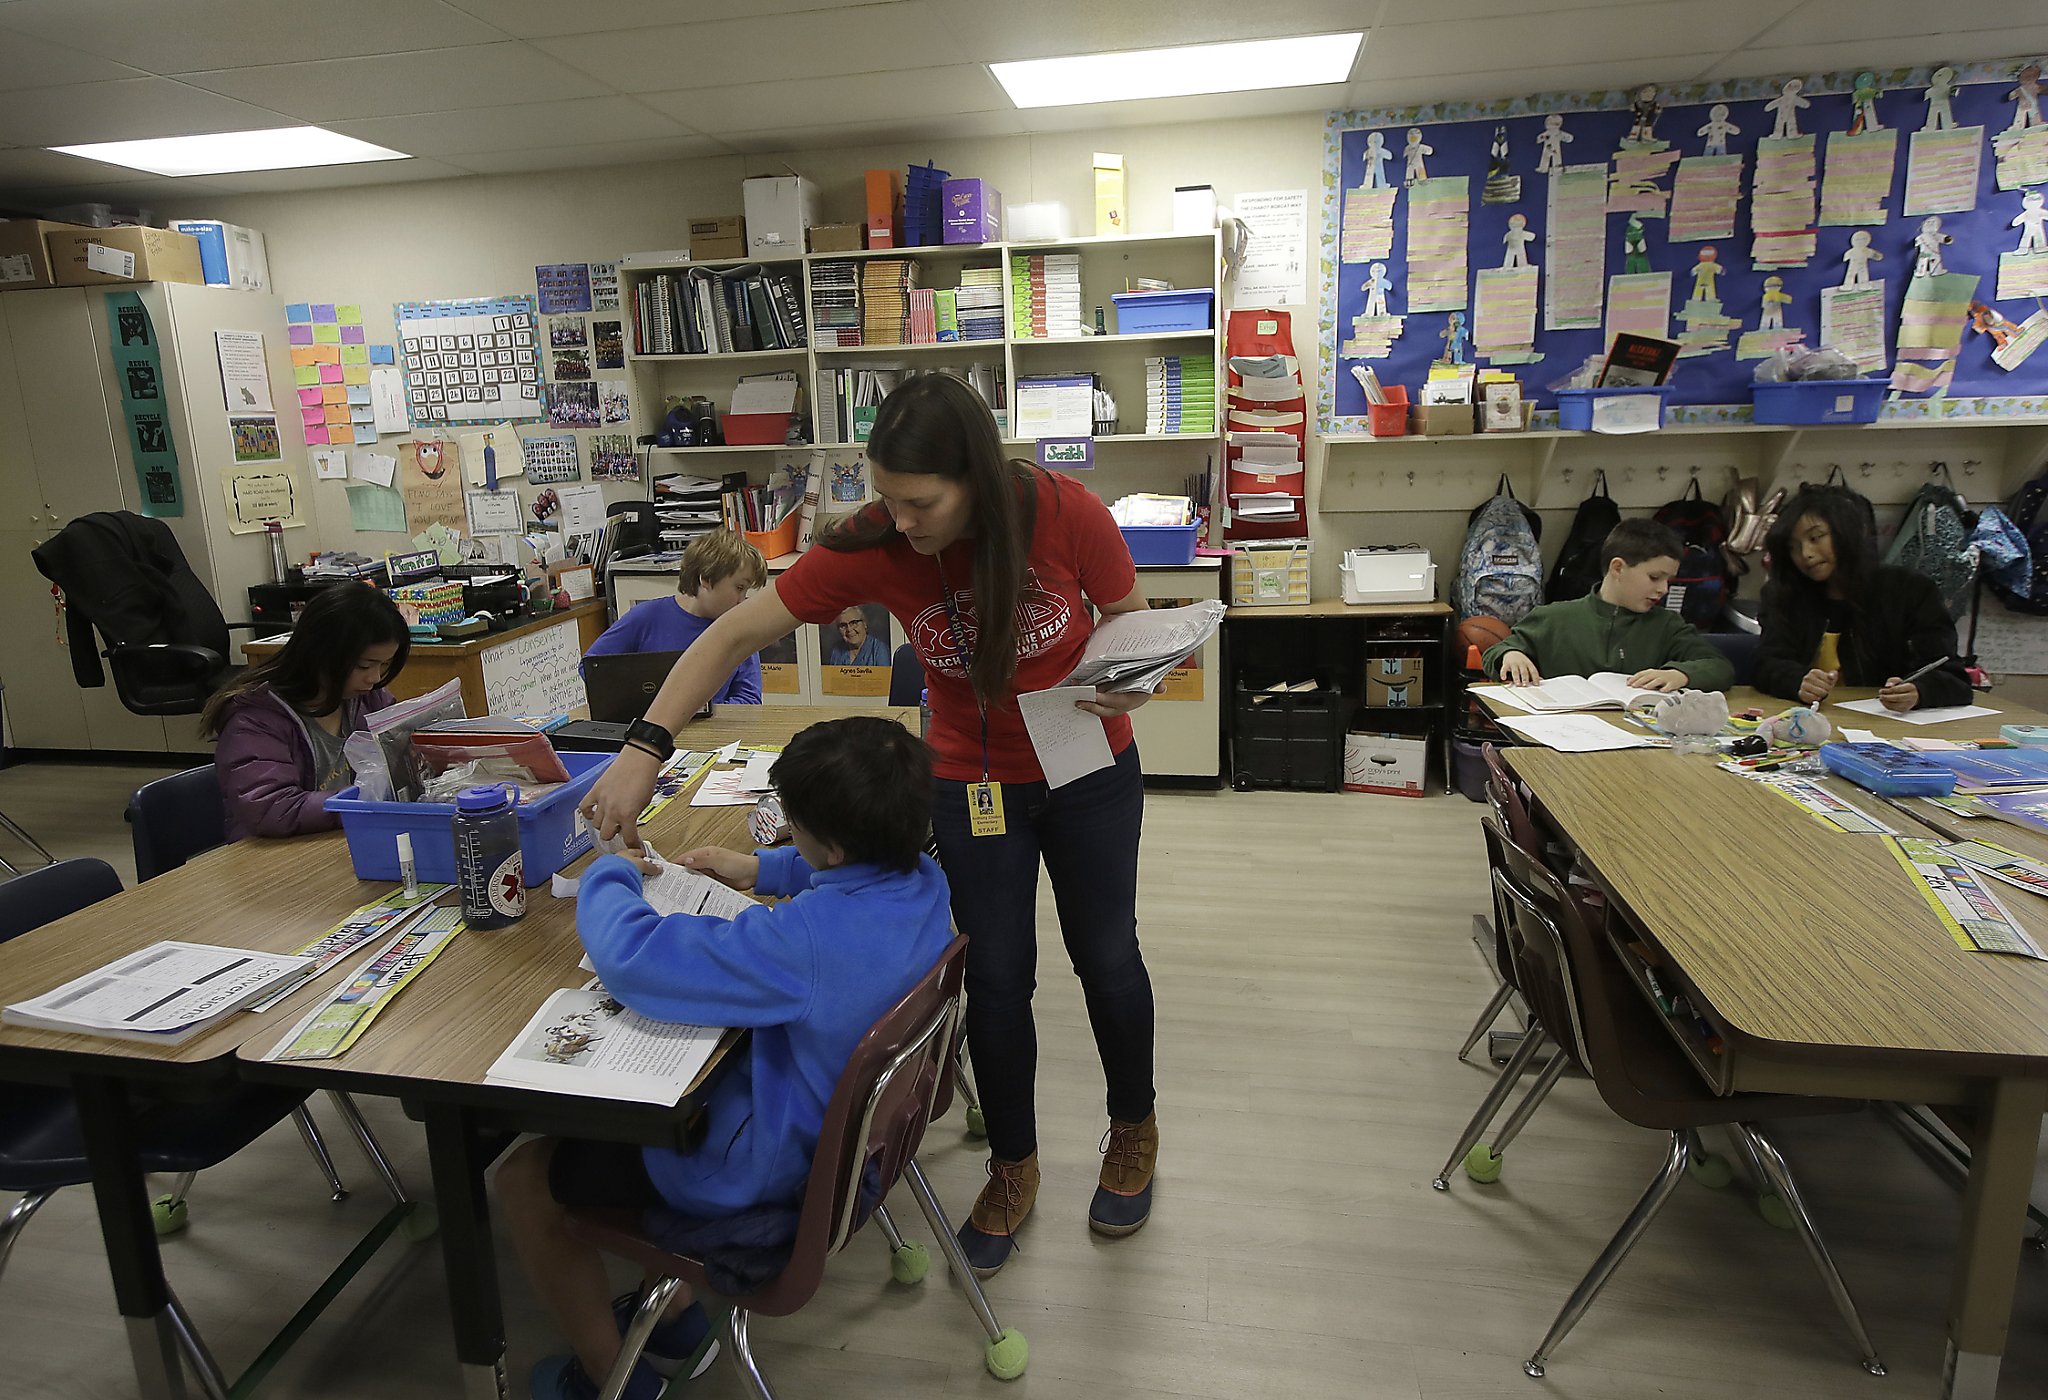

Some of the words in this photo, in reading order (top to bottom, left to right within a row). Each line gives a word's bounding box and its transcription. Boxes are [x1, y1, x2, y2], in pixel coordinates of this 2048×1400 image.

[500, 319, 506, 329] 1
[516, 316, 524, 326] 2
[408, 341, 415, 350] 3
[425, 338, 432, 348] 4
[445, 338, 452, 346] 5
[462, 337, 468, 346] 6
[482, 336, 489, 346] 7
[499, 336, 506, 346] 8
[520, 334, 526, 344] 9
[410, 358, 418, 366] 10
[429, 357, 437, 366] 11
[446, 356, 456, 365] 12
[463, 354, 472, 364] 13
[483, 353, 492, 363] 14
[500, 352, 509, 360] 15
[520, 350, 530, 360] 16
[413, 374, 420, 383] 17
[428, 374, 438, 384] 18
[448, 372, 456, 382] 19
[465, 372, 474, 380] 20
[486, 371, 494, 380] 21
[502, 370, 512, 379] 22
[522, 370, 533, 378] 23
[430, 390, 440, 399] 25
[449, 390, 459, 400] 26
[468, 389, 478, 398] 27
[486, 389, 496, 398] 28
[134, 413, 162, 421] RECYCLE
[1046, 445, 1085, 460] Scratch
[430, 502, 453, 512] LOVE
[395, 558, 416, 572] Turn
[1040, 607, 1071, 639] HEART
[482, 647, 504, 664] What
[508, 646, 515, 657] is
[518, 624, 563, 655] Consent?
[926, 656, 961, 668] TEACH
[488, 688, 506, 707] What
[508, 685, 520, 698] does
[563, 834, 590, 856] booksourc
[492, 866, 507, 909] WILDERNESS
[1922, 873, 1950, 892] Zev
[180, 968, 280, 1020] Conversions
